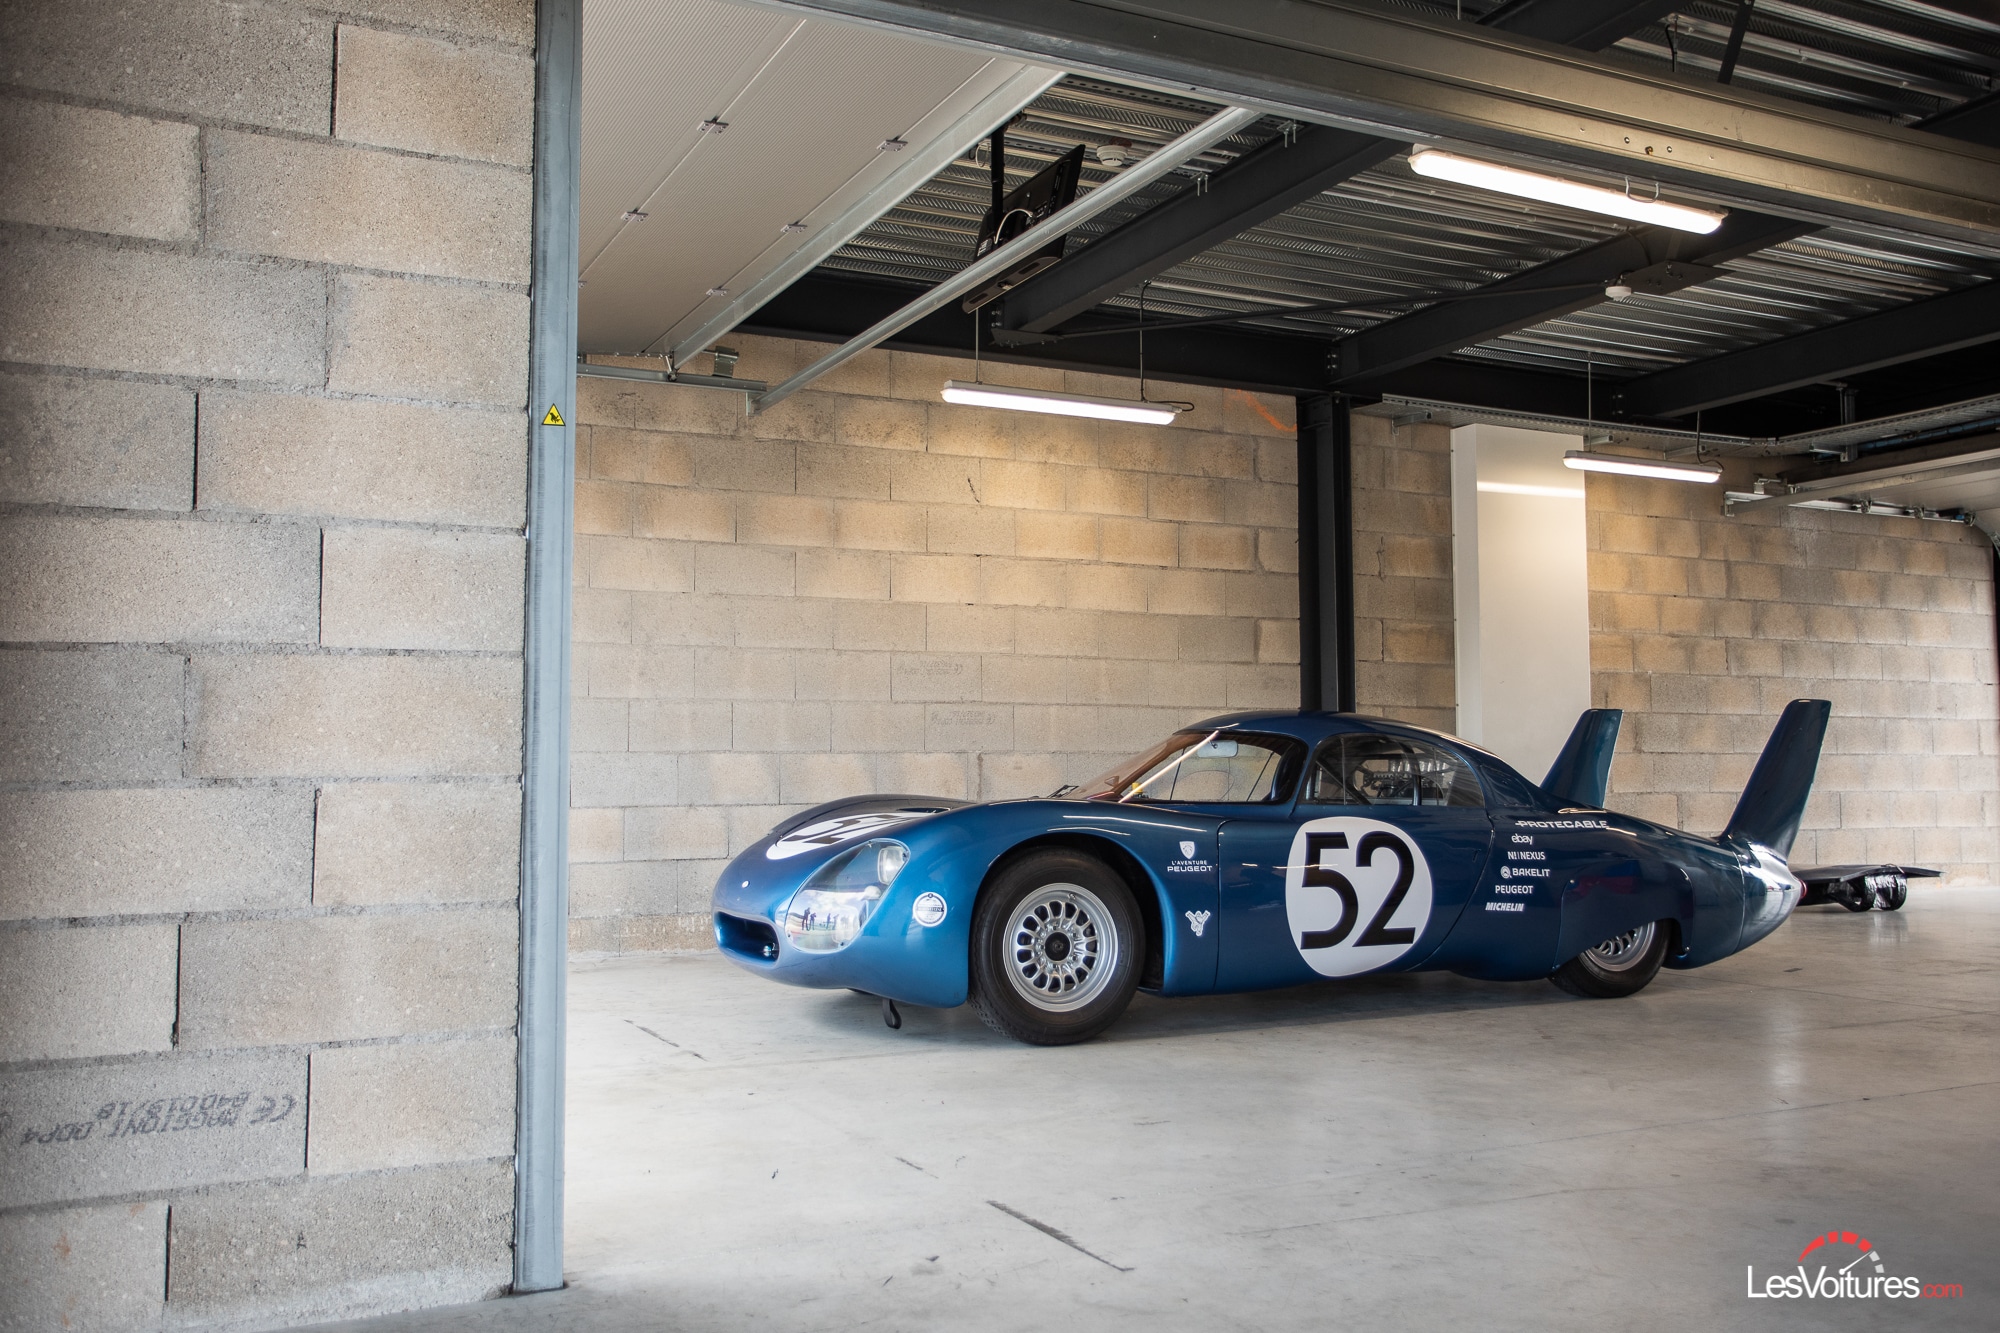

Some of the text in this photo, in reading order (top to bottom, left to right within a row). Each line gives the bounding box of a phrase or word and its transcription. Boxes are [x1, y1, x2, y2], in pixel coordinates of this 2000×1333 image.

[1515, 820, 1609, 829] PROTECABLE
[1511, 833, 1533, 845] ebay
[1512, 867, 1550, 877] BAKELIT
[1300, 830, 1416, 950] 52
[1495, 885, 1533, 894] PEUGEOT
[1485, 902, 1524, 912] MICHELIN
